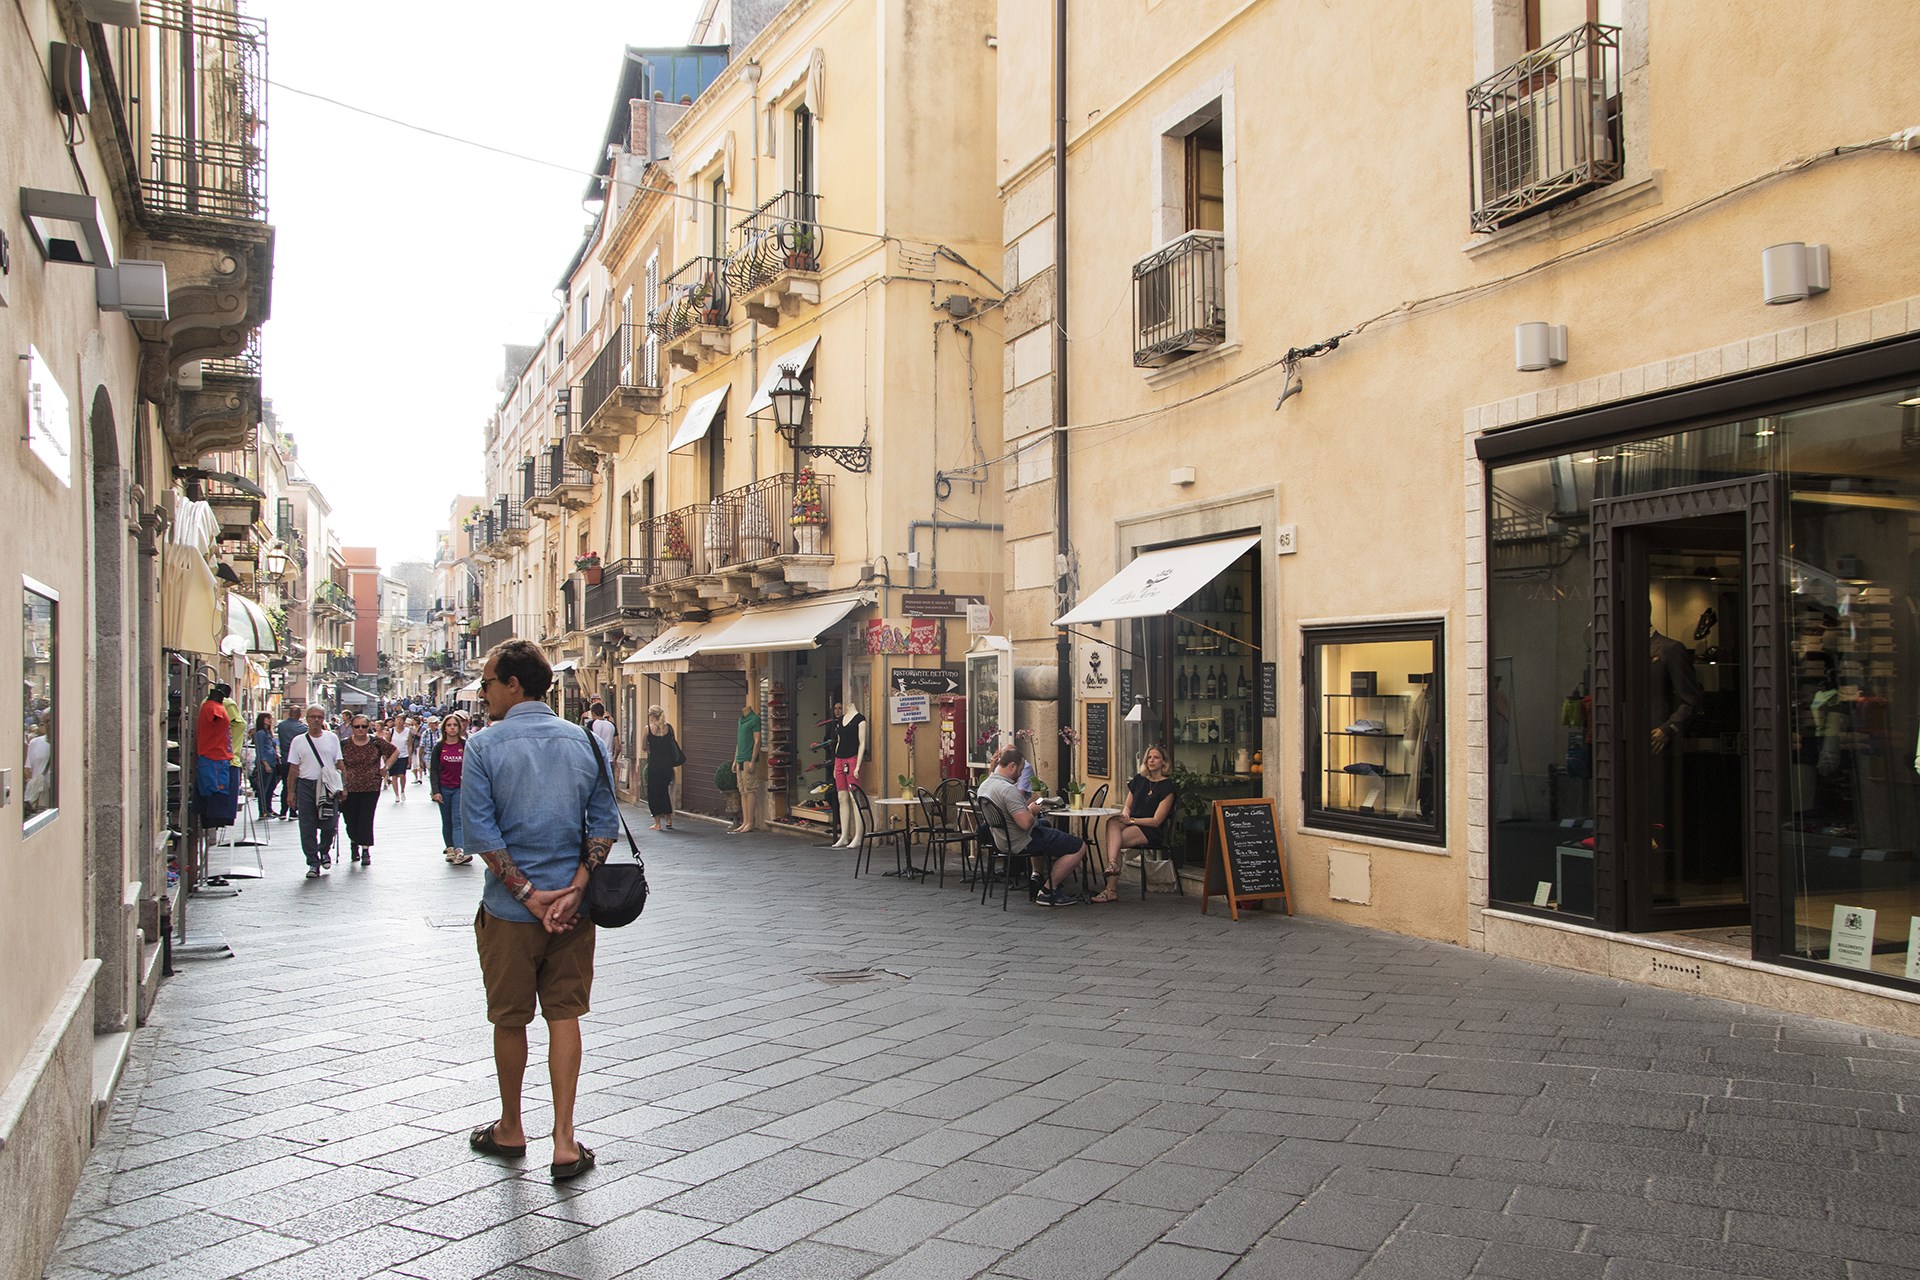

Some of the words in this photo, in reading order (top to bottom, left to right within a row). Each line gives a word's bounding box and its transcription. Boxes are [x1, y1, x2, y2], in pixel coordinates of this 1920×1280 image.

[1280, 533, 1290, 547] 65
[930, 670, 959, 678] NETTUNO
[1838, 943, 1864, 951] REGGIMENTO
